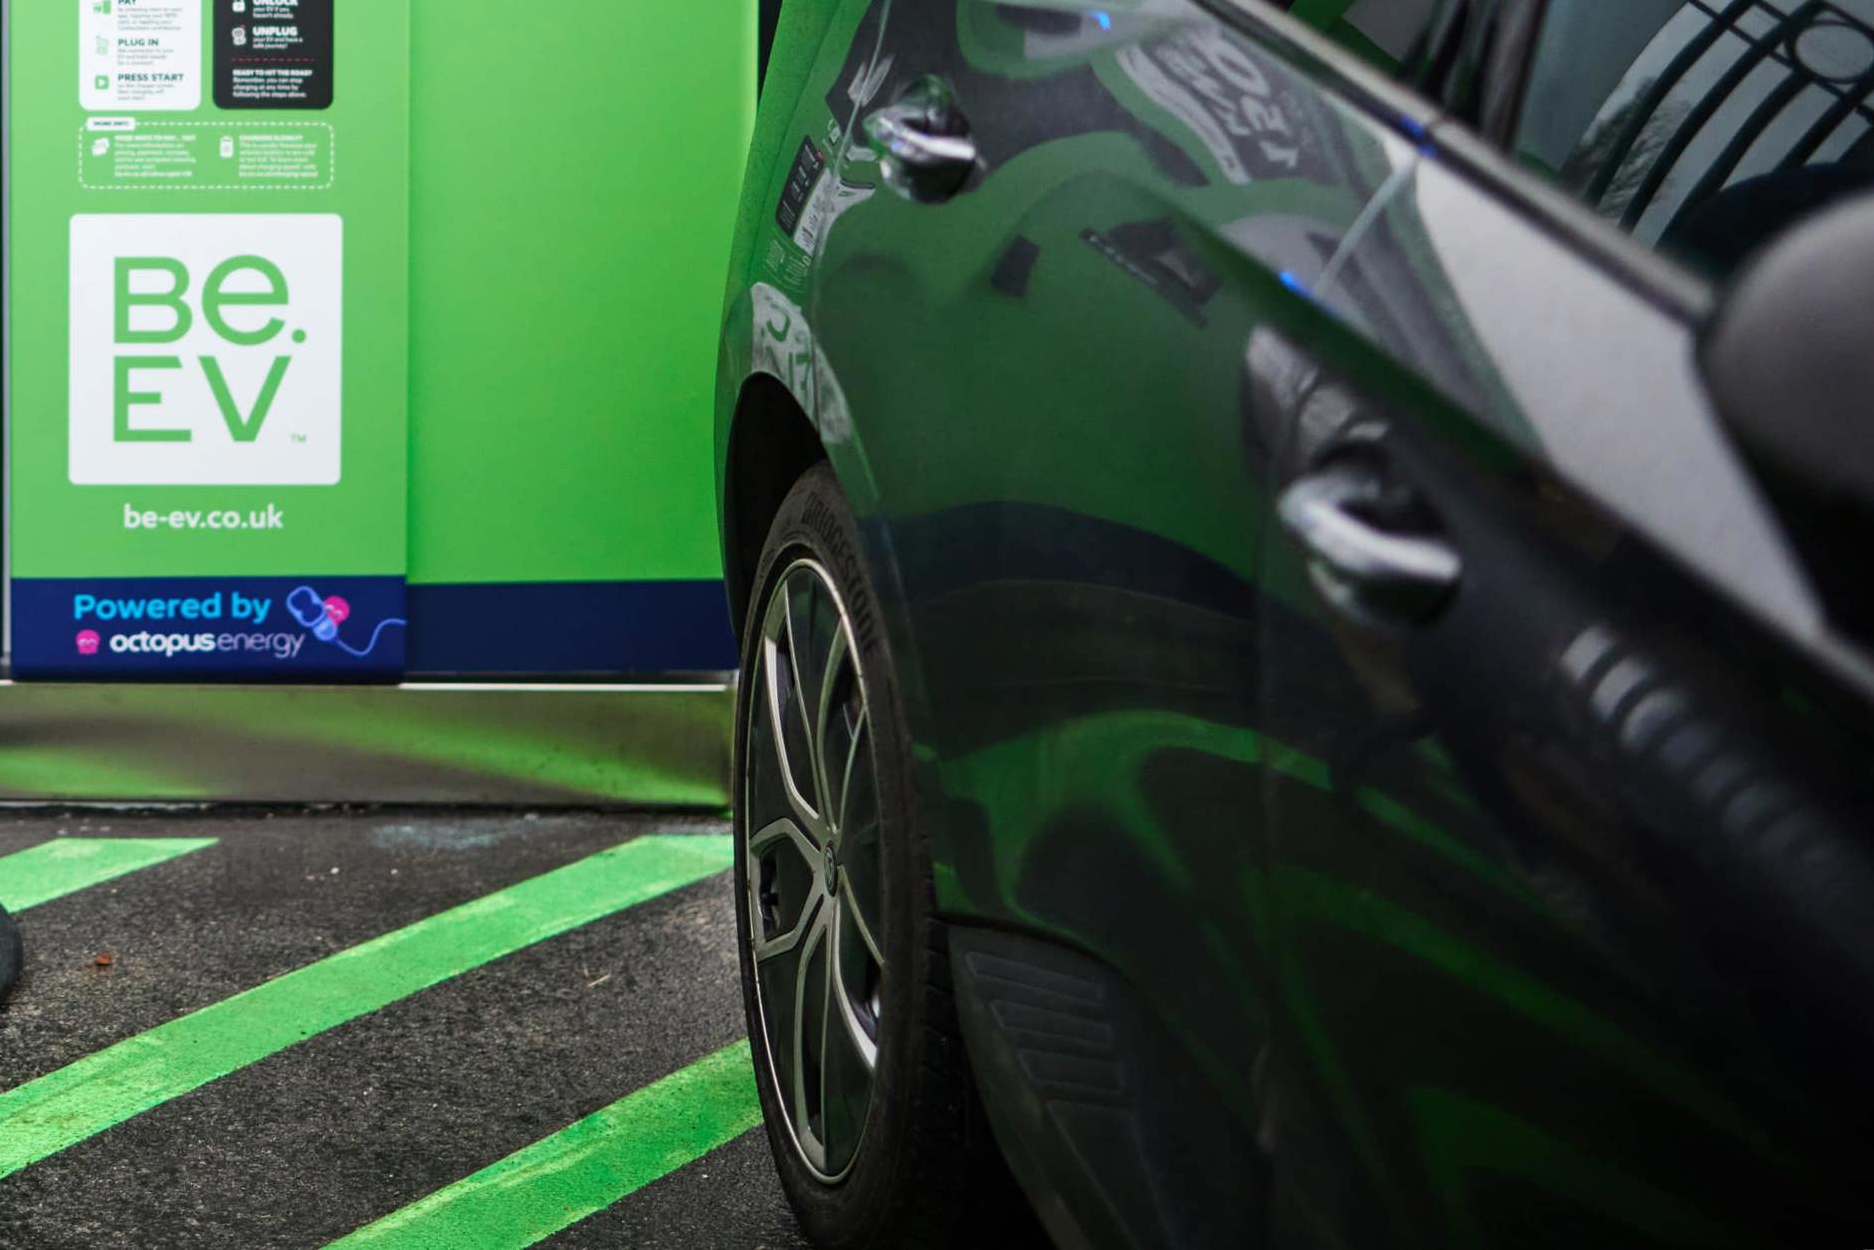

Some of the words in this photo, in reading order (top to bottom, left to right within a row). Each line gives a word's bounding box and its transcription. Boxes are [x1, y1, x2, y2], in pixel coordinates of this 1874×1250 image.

[118, 38, 145, 46] PLUG
[147, 38, 159, 46] IN
[252, 26, 298, 36] UNPLUG
[118, 73, 148, 81] PRESS
[151, 73, 184, 81] START
[114, 255, 307, 346] Be.
[114, 355, 292, 442] EV
[124, 503, 283, 529] be-ev.co.uk
[74, 593, 222, 620] Powered
[232, 592, 271, 624] by
